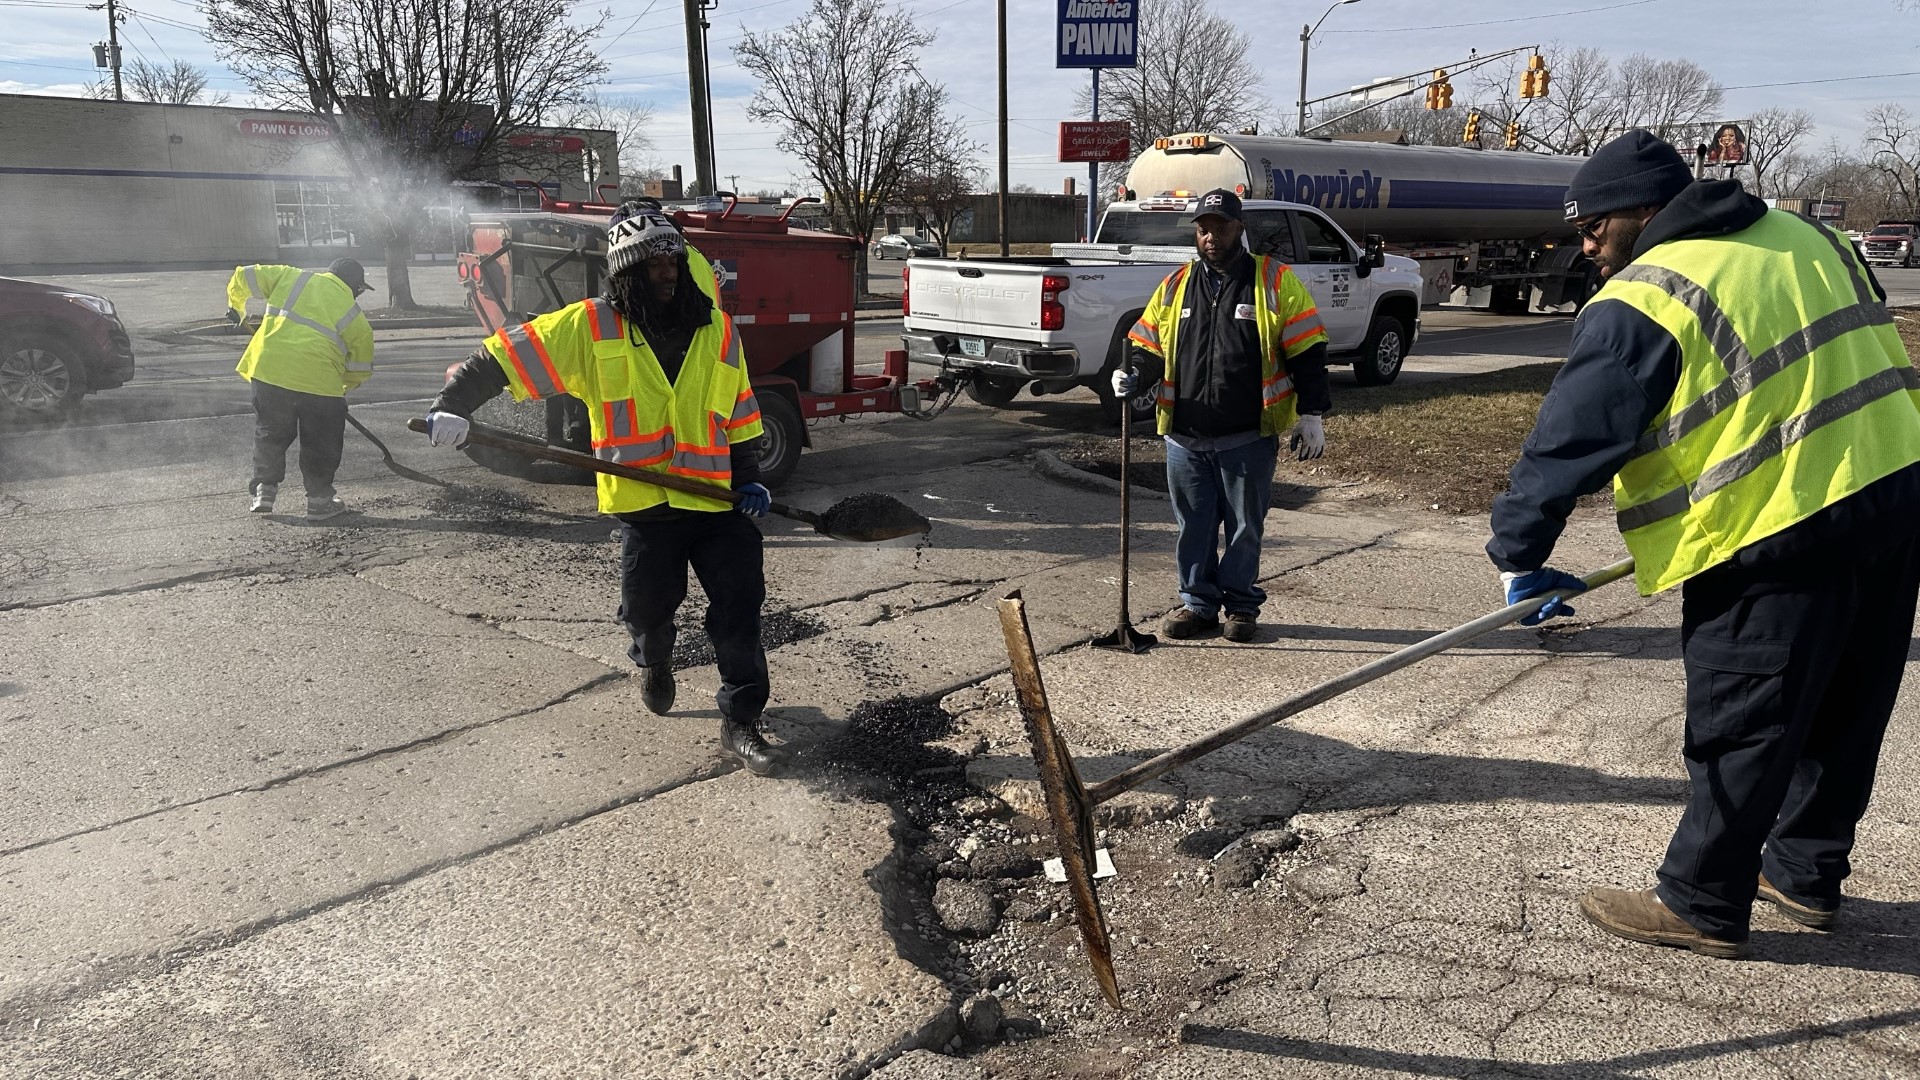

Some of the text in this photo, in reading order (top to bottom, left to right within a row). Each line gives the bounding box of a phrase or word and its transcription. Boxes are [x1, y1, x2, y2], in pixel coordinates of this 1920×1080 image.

[1066, 0, 1132, 18] America
[1062, 23, 1133, 55] PAWN
[252, 123, 329, 136] PAWN & LOAN
[1272, 168, 1382, 209] Norrick
[718, 248, 744, 257] WORKS
[915, 282, 1032, 301] CHEVROLET
